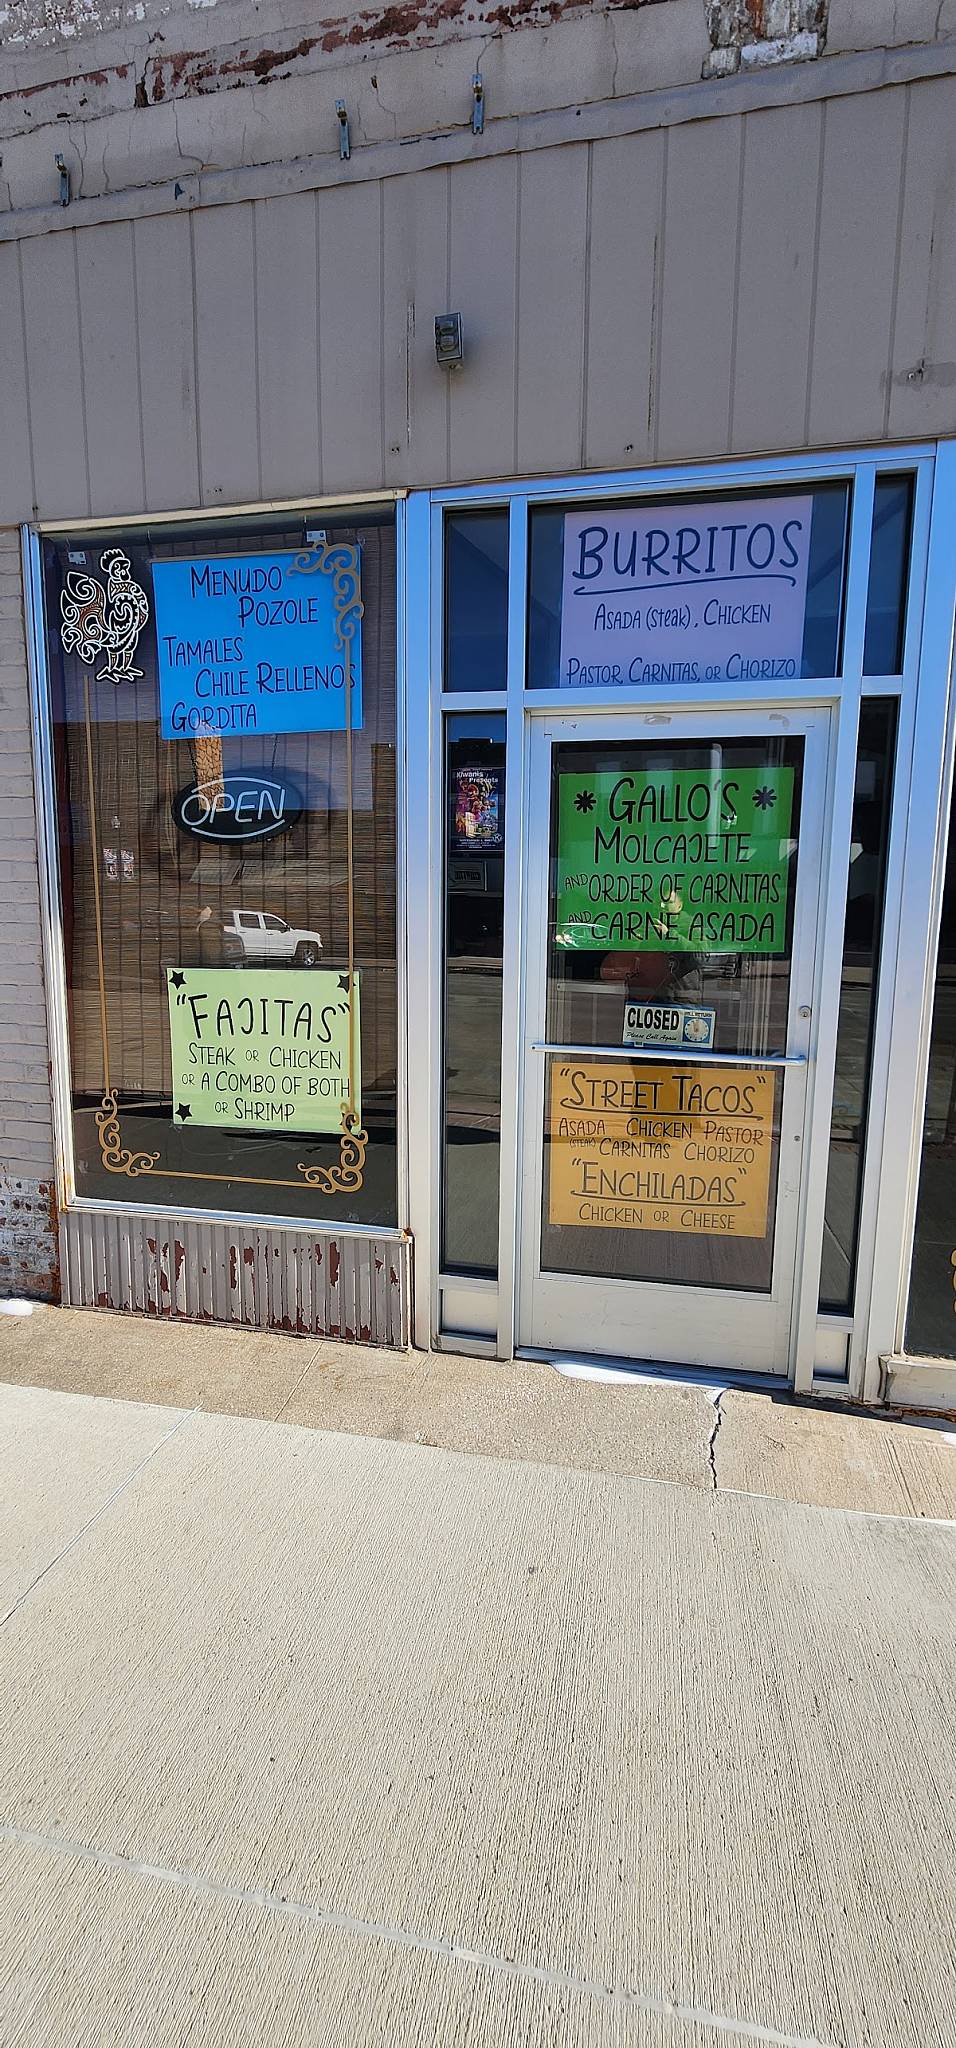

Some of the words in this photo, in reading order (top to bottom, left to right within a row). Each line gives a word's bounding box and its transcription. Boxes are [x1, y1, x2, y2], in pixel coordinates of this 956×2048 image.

[572, 520, 802, 580] BURRITOS
[191, 565, 282, 598] MENUDO
[238, 596, 318, 628] POZOLE
[594, 603, 641, 631] ASADA
[704, 599, 771, 627] CHICKEN
[163, 636, 243, 667] TAMALES
[195, 669, 249, 698] CHILE
[256, 662, 356, 694] RELLENOS
[566, 658, 624, 684] PASTOR,
[629, 657, 700, 683] CARNITAS,
[726, 653, 796, 680] CHORIZO
[172, 703, 257, 732] GORDITA
[181, 788, 286, 826] OPEN
[608, 777, 740, 824] GALLO'S
[594, 826, 751, 865] MOLCAJETE
[565, 873, 588, 890] AND
[588, 874, 653, 903] ORDER
[660, 873, 686, 903] OF
[689, 873, 781, 904] CARNITAS
[568, 911, 592, 925] AND
[591, 911, 679, 941] CARNE
[689, 912, 775, 942] ASADA
[177, 994, 350, 1043] "FAJITAS"
[627, 1008, 680, 1030] CLOSED
[626, 1031, 644, 1039] Please
[659, 1034, 677, 1042] Again
[189, 1043, 236, 1066] STEAK
[269, 1047, 341, 1069] CHICKEN
[201, 1072, 210, 1090] A
[216, 1071, 276, 1093] COMBO
[281, 1076, 302, 1095] OF
[307, 1078, 350, 1098] BOTH
[560, 1068, 664, 1109] "STREET
[672, 1075, 767, 1113] TACOS"
[234, 1098, 295, 1122] SHRIMP
[559, 1118, 605, 1137] ASADA
[626, 1117, 692, 1139] CHICKEN
[703, 1121, 764, 1146] PASTOR
[569, 1138, 596, 1148] (STEAK)
[599, 1138, 671, 1159] CARNITAS
[684, 1143, 754, 1164] CHORIZO
[571, 1158, 747, 1203] "ENCHILADAS"
[579, 1203, 643, 1223] CHICKEN
[680, 1210, 736, 1229] CHEESE
